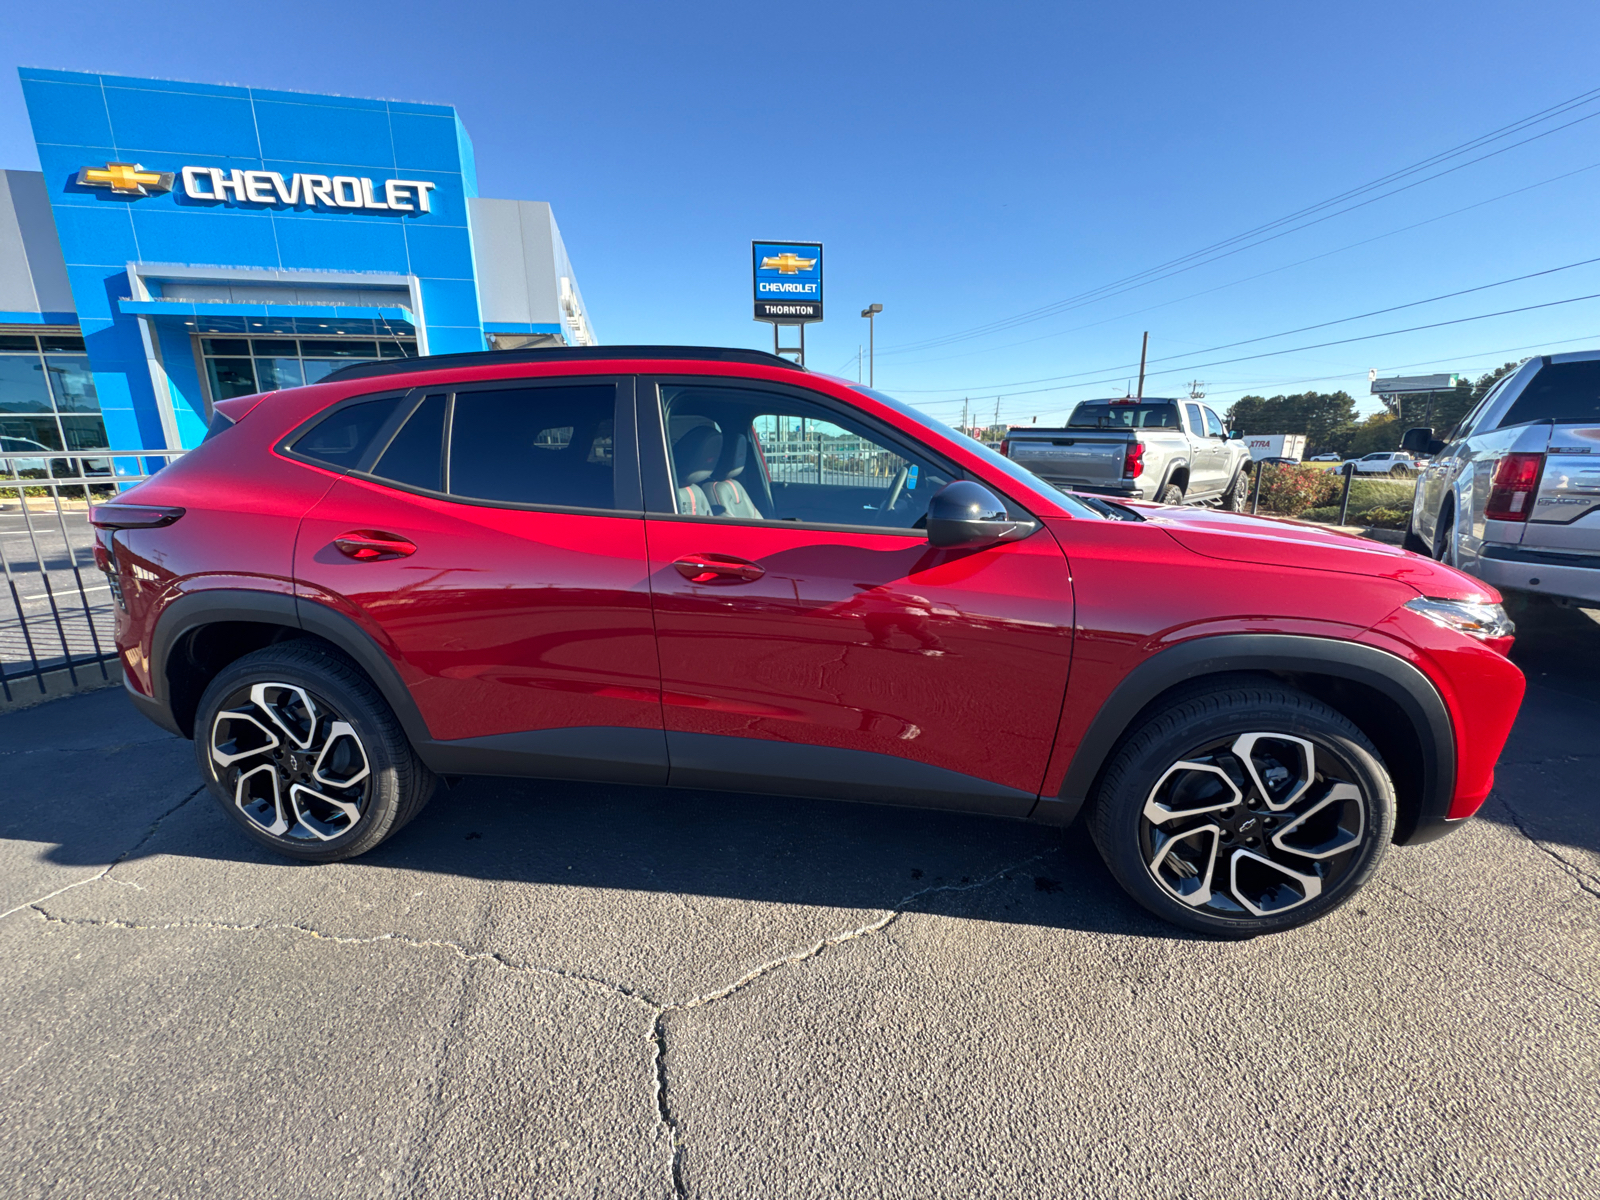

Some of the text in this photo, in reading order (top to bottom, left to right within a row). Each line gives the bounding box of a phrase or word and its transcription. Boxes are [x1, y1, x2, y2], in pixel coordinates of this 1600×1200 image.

[182, 166, 435, 214] CHEVROLET
[759, 282, 817, 293] CHEVROLET
[764, 305, 814, 315] THORNTON
[1249, 440, 1271, 449] XTRA
